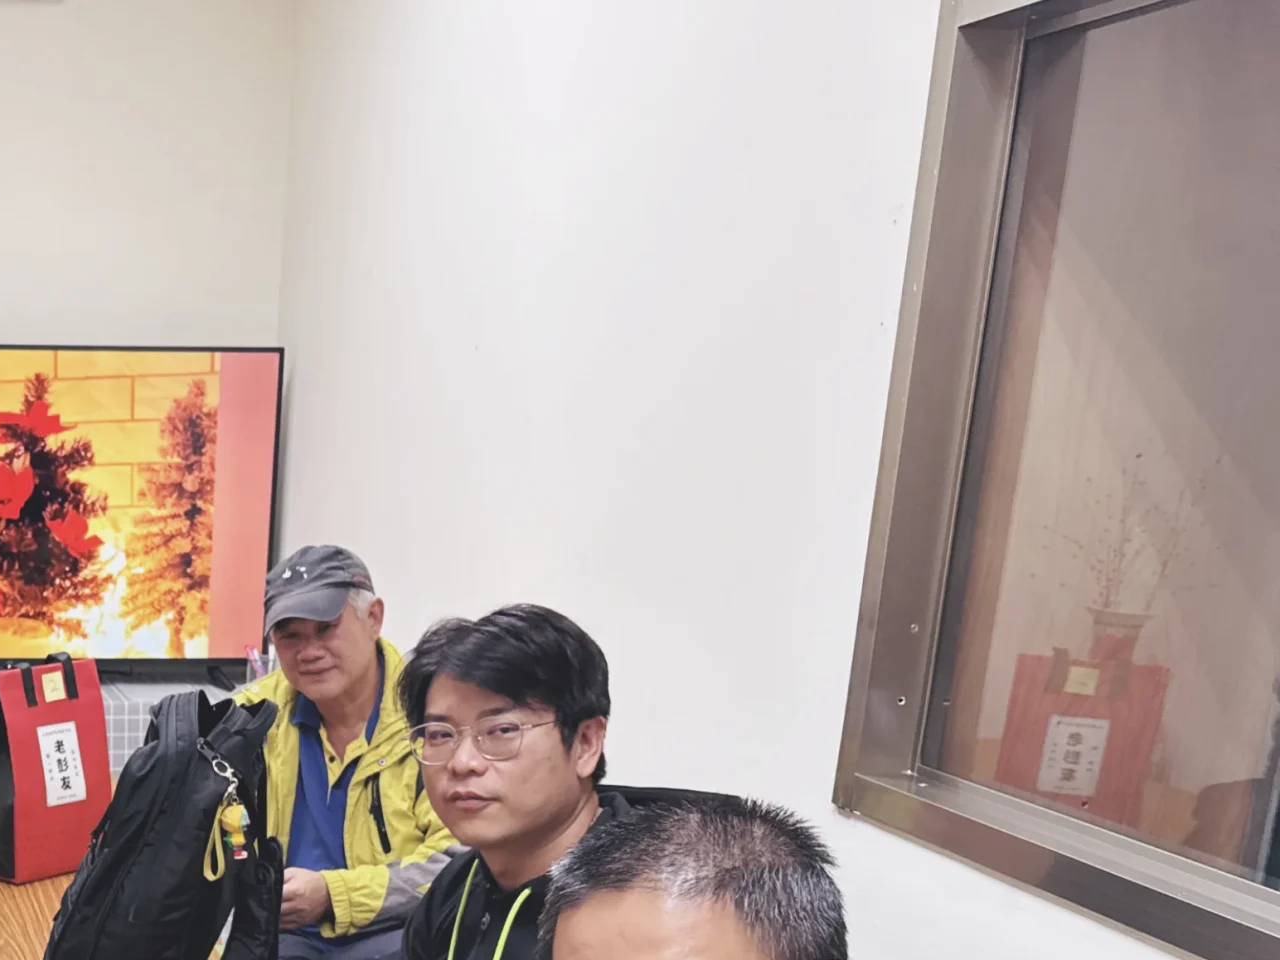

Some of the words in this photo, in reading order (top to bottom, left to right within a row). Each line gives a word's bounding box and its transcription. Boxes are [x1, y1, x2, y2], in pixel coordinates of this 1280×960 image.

[48, 678, 61, 693] 2
[54, 739, 72, 791] 老彭友
